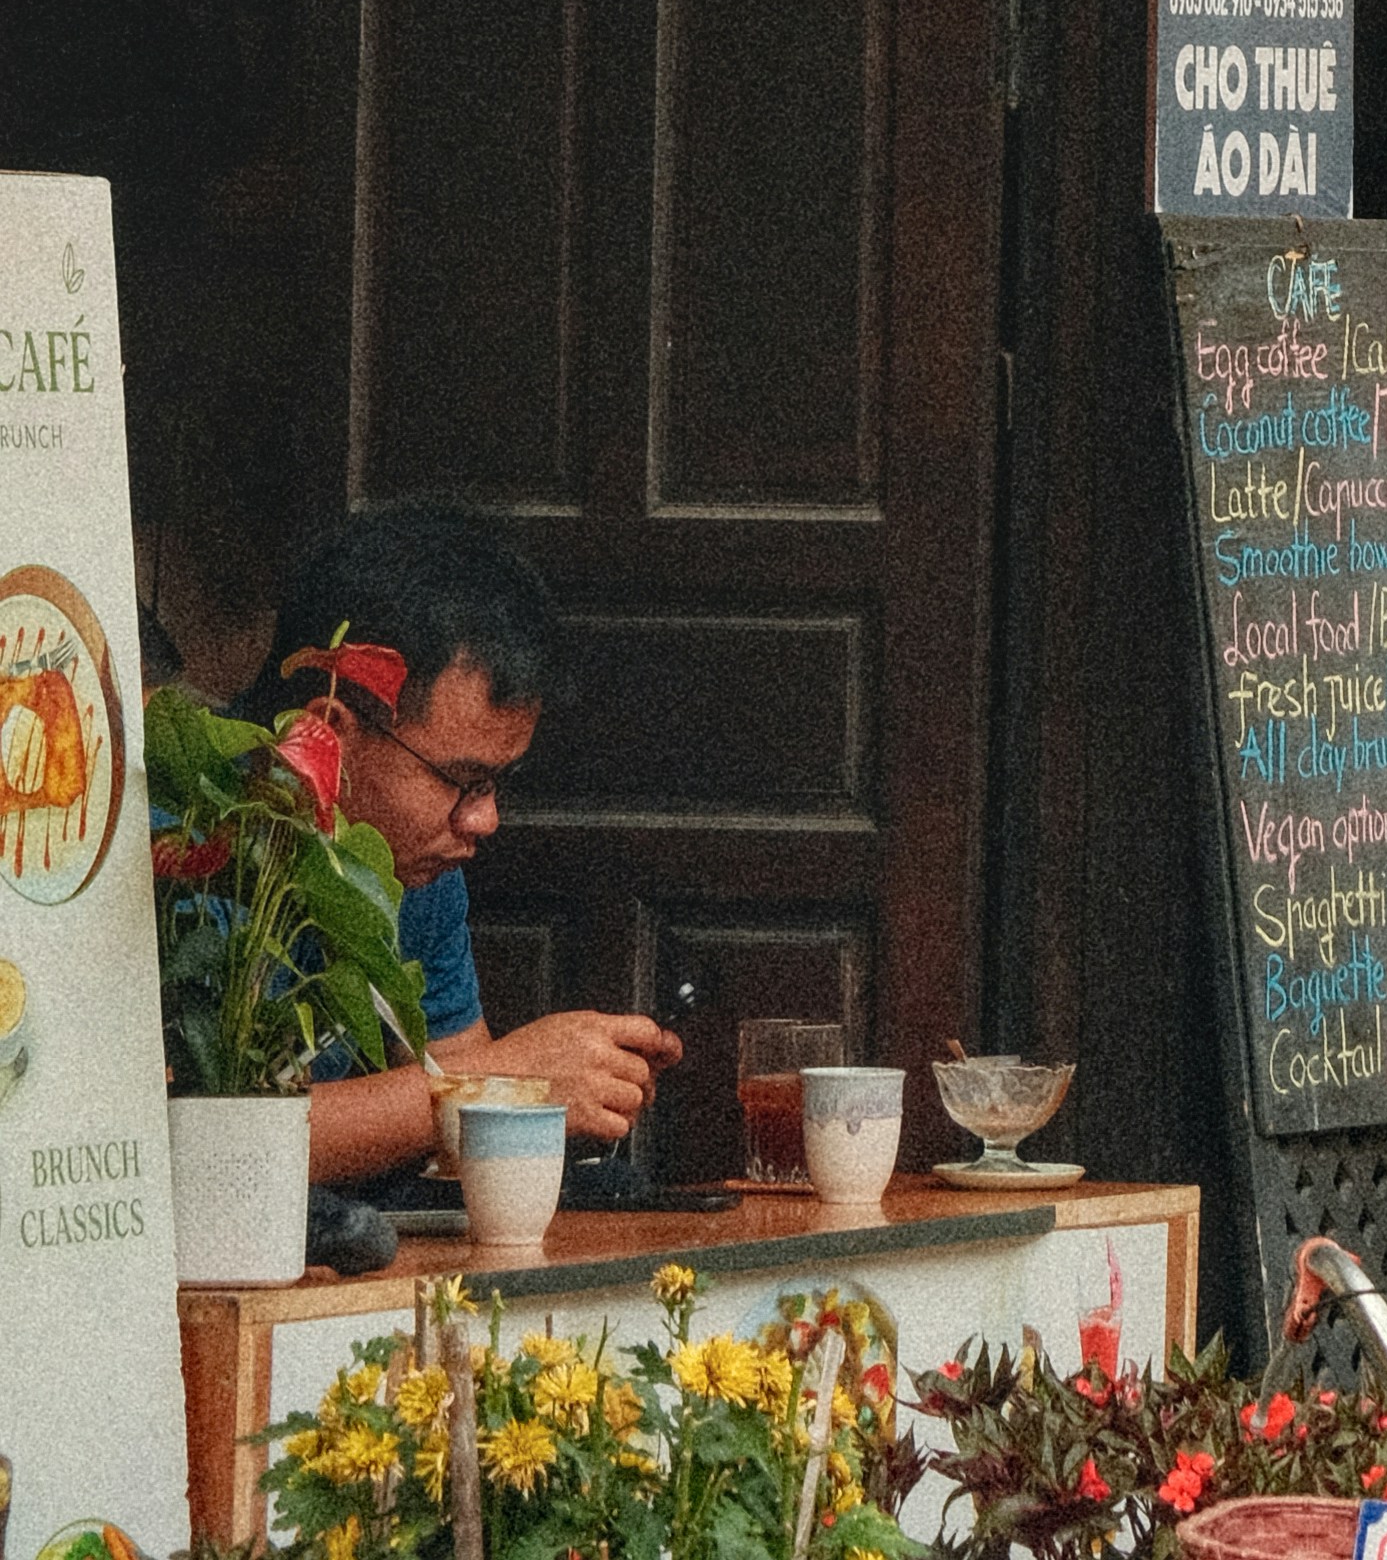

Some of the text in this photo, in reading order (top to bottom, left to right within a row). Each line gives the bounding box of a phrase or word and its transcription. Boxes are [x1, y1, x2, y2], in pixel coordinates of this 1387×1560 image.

[1175, 39, 1338, 112] CHO THUÊ
[1194, 123, 1317, 197] ÁO DÀI
[1196, 318, 1254, 415] Egg
[1257, 318, 1328, 380] coffee
[1200, 390, 1297, 458] Coconut
[1215, 519, 1341, 588] Smoothie
[1223, 592, 1300, 668] Local
[1307, 590, 1360, 662] food
[1240, 718, 1285, 785] All
[1297, 712, 1347, 794] day
[1240, 799, 1325, 895] Vegan
[1265, 930, 1387, 1036] Baguette
[31, 1138, 142, 1189] BRUNCH
[20, 1197, 146, 1250] CLASSICS
